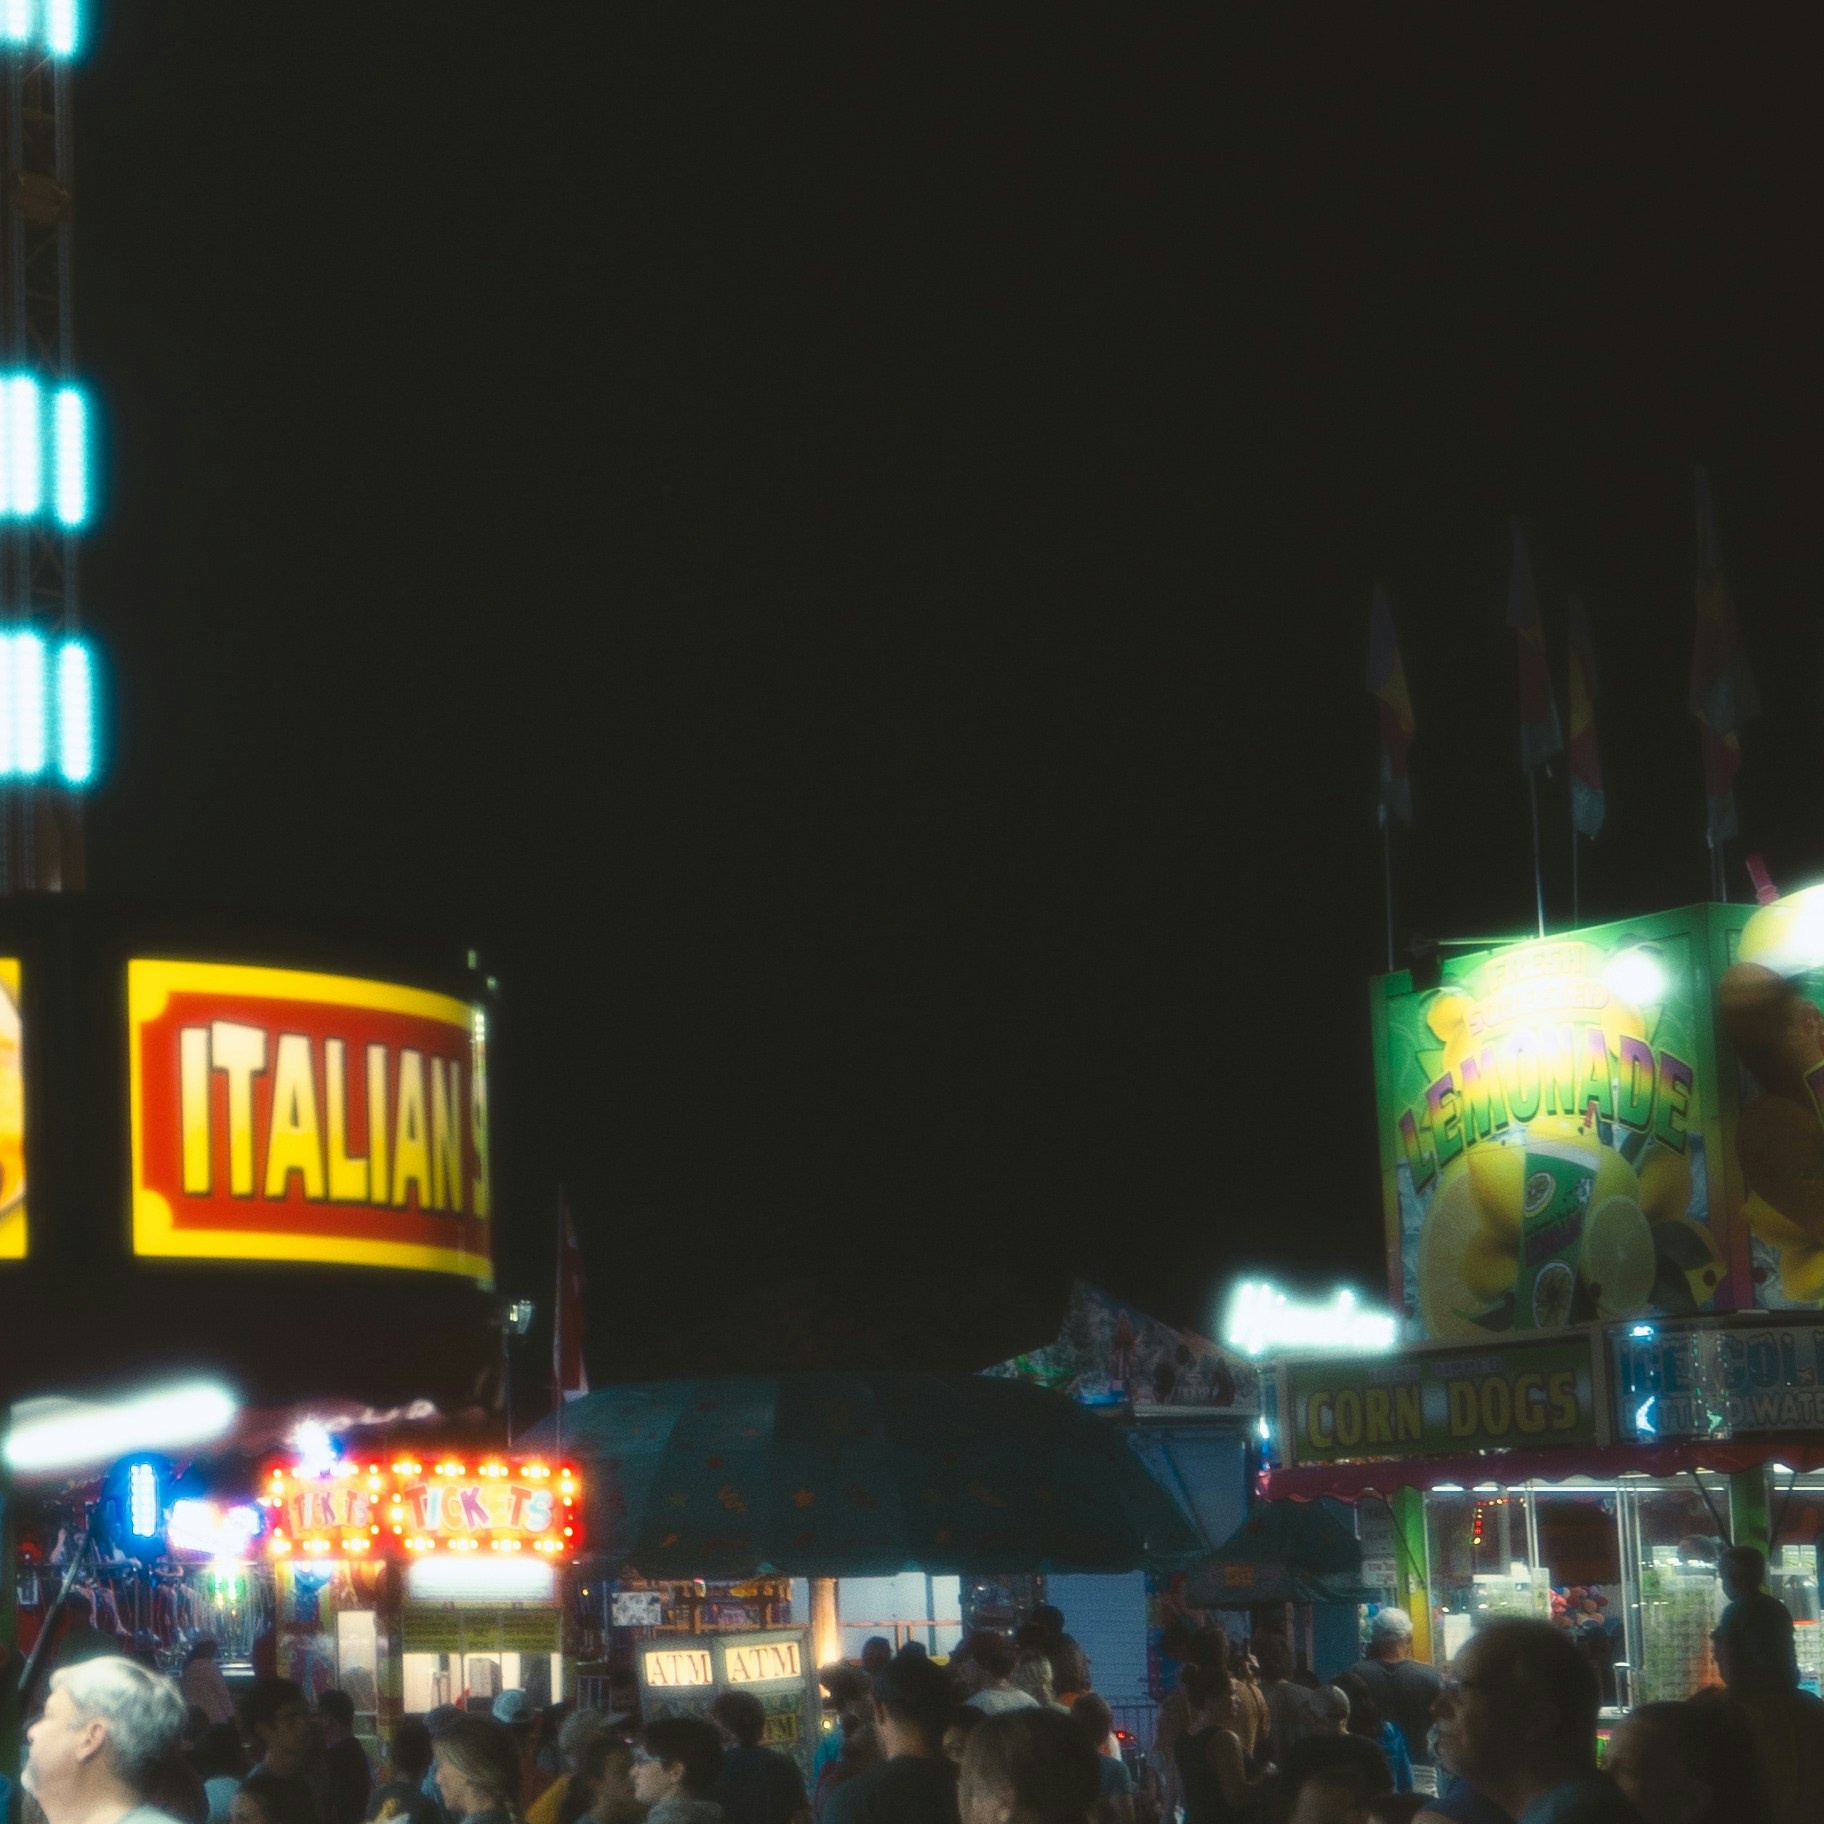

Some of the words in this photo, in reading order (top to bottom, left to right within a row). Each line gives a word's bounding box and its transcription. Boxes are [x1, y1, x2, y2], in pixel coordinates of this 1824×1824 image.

[179, 1019, 463, 1216] ITALIAN
[1398, 1027, 1694, 1193] LEMONADE
[1717, 1329, 1824, 1392] COL
[1307, 1384, 1423, 1450] CORN
[1447, 1370, 1579, 1438] DOGS
[404, 1484, 554, 1532] TICKETS
[651, 1654, 710, 1685] ATM
[731, 1645, 799, 1681] ATM
